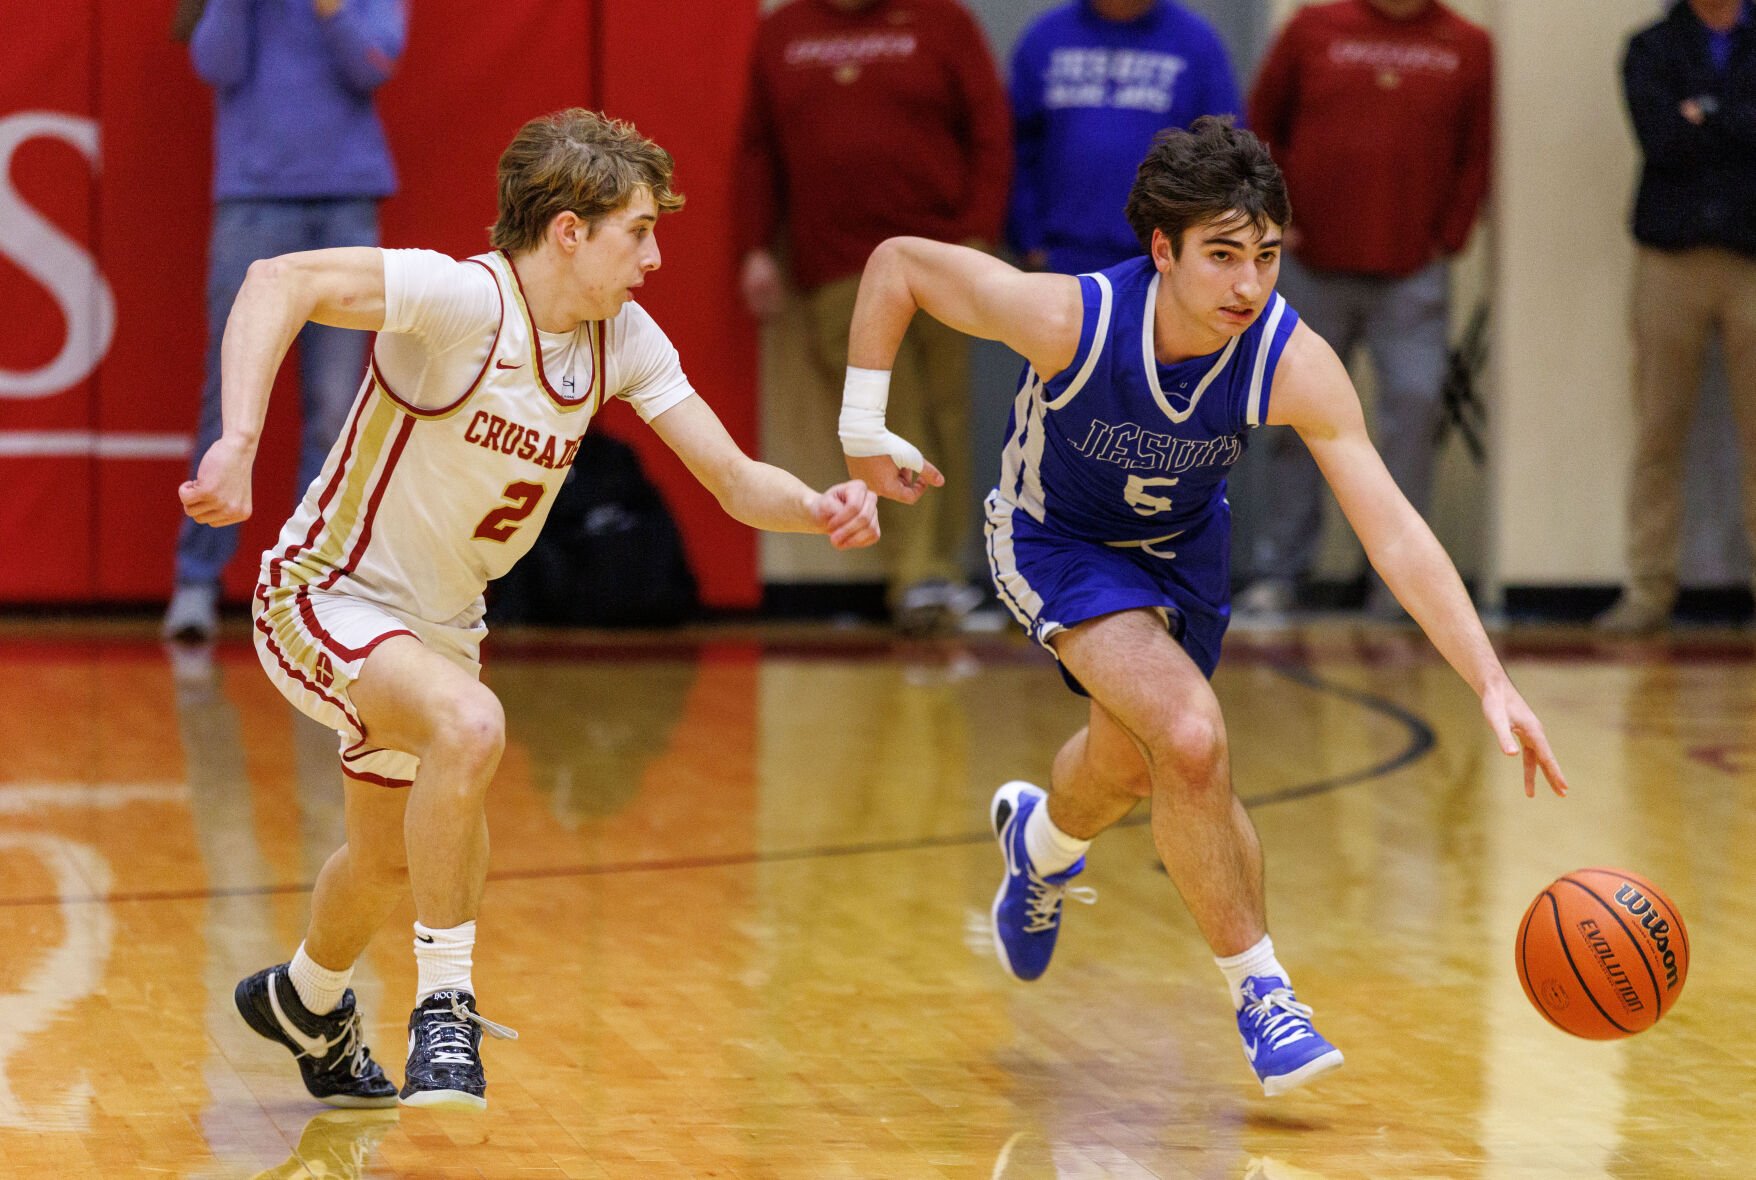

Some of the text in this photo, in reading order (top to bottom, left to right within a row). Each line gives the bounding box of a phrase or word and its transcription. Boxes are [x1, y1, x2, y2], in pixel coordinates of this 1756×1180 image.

[470, 479, 547, 544] 2
[1124, 474, 1179, 517] 5
[1579, 918, 1644, 1013] EVOLUTION
[1613, 882, 1679, 991] Wilson
